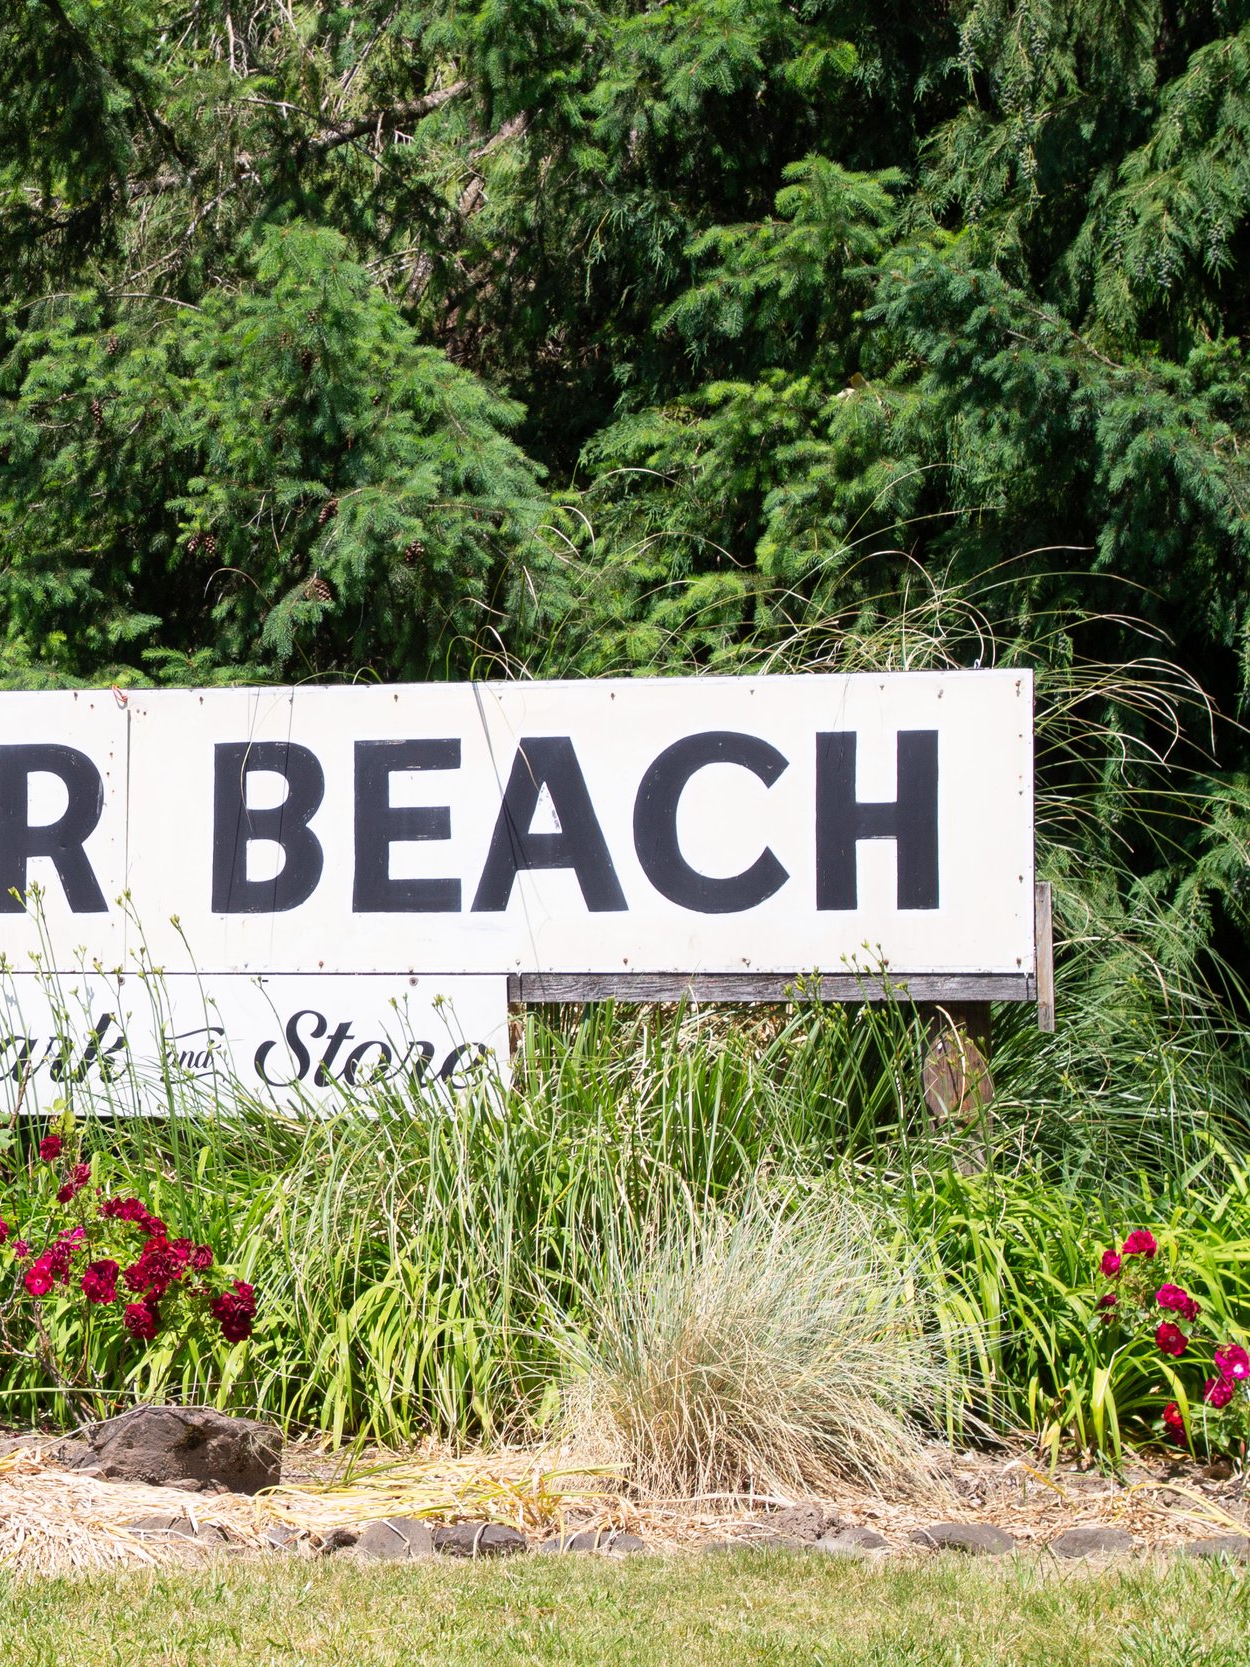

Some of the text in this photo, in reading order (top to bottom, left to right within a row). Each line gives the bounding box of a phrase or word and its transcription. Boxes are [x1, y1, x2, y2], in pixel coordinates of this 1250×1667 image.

[210, 729, 940, 915] BEACH
[162, 1036, 223, 1074] and
[254, 1009, 491, 1090] Store
